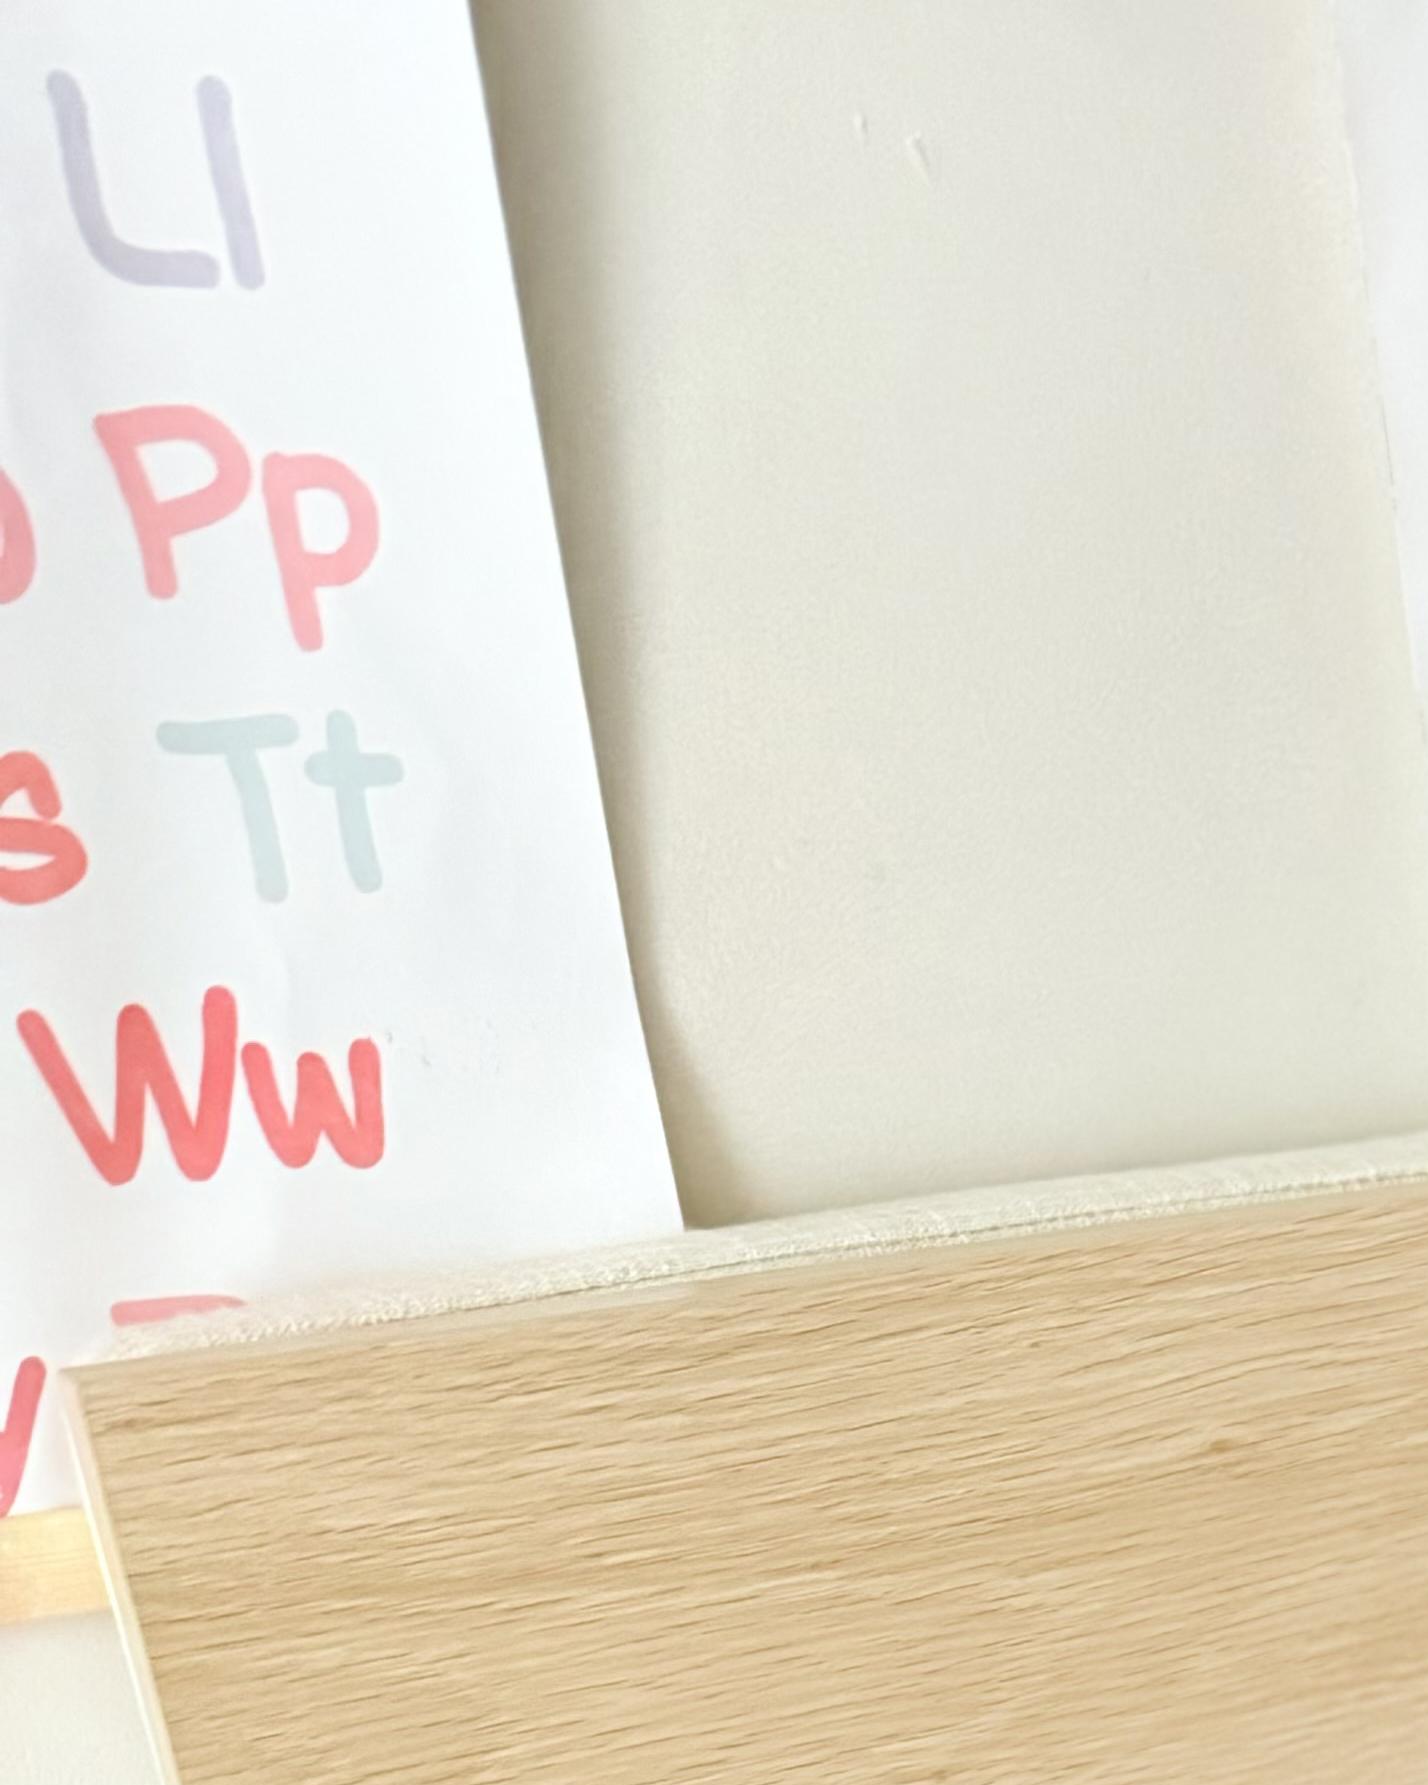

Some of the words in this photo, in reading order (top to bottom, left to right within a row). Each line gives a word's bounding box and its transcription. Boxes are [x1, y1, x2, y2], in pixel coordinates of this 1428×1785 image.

[91, 405, 379, 652] Pp
[155, 709, 404, 903] Tt
[16, 986, 385, 1186] Ww
